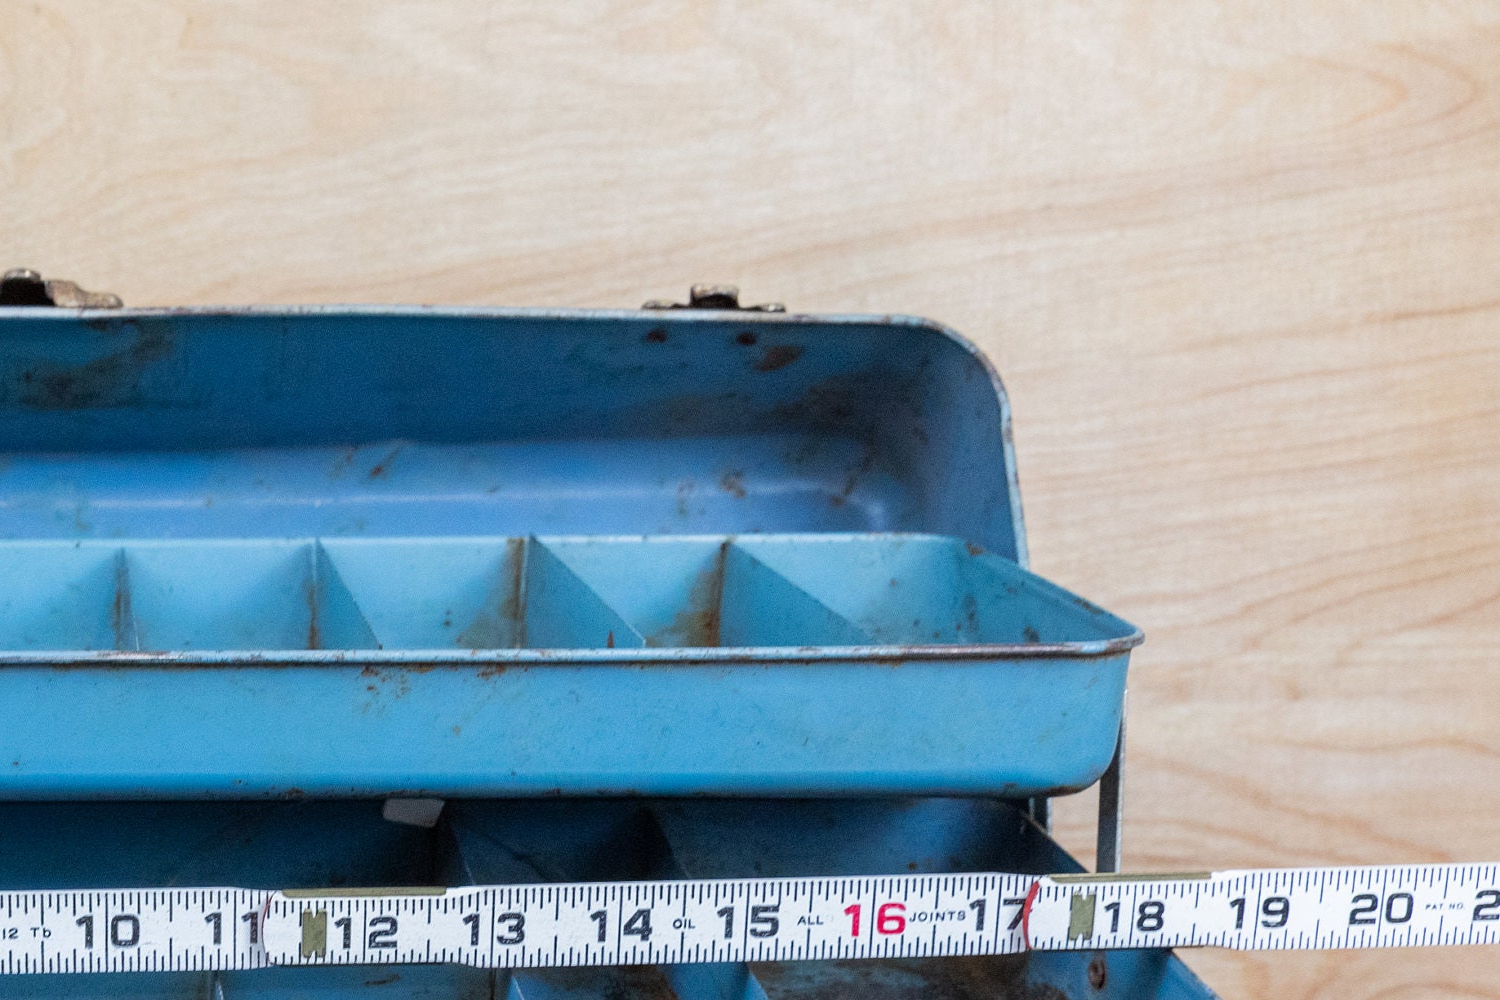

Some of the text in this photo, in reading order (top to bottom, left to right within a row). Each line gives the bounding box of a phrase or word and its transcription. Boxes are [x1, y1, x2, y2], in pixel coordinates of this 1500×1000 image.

[76, 914, 140, 948] 10
[204, 912, 258, 945] 11
[334, 916, 399, 949] 12
[462, 912, 526, 946] 13
[589, 907, 652, 943] 14
[672, 918, 696, 930] OIL
[716, 904, 780, 938] 15
[796, 914, 824, 926] ALL
[844, 902, 907, 937] 16
[908, 910, 966, 923] JOINTS
[968, 897, 1026, 933] 17
[1103, 900, 1166, 933] 18
[1229, 896, 1290, 930] 19
[1349, 892, 1415, 925] 20
